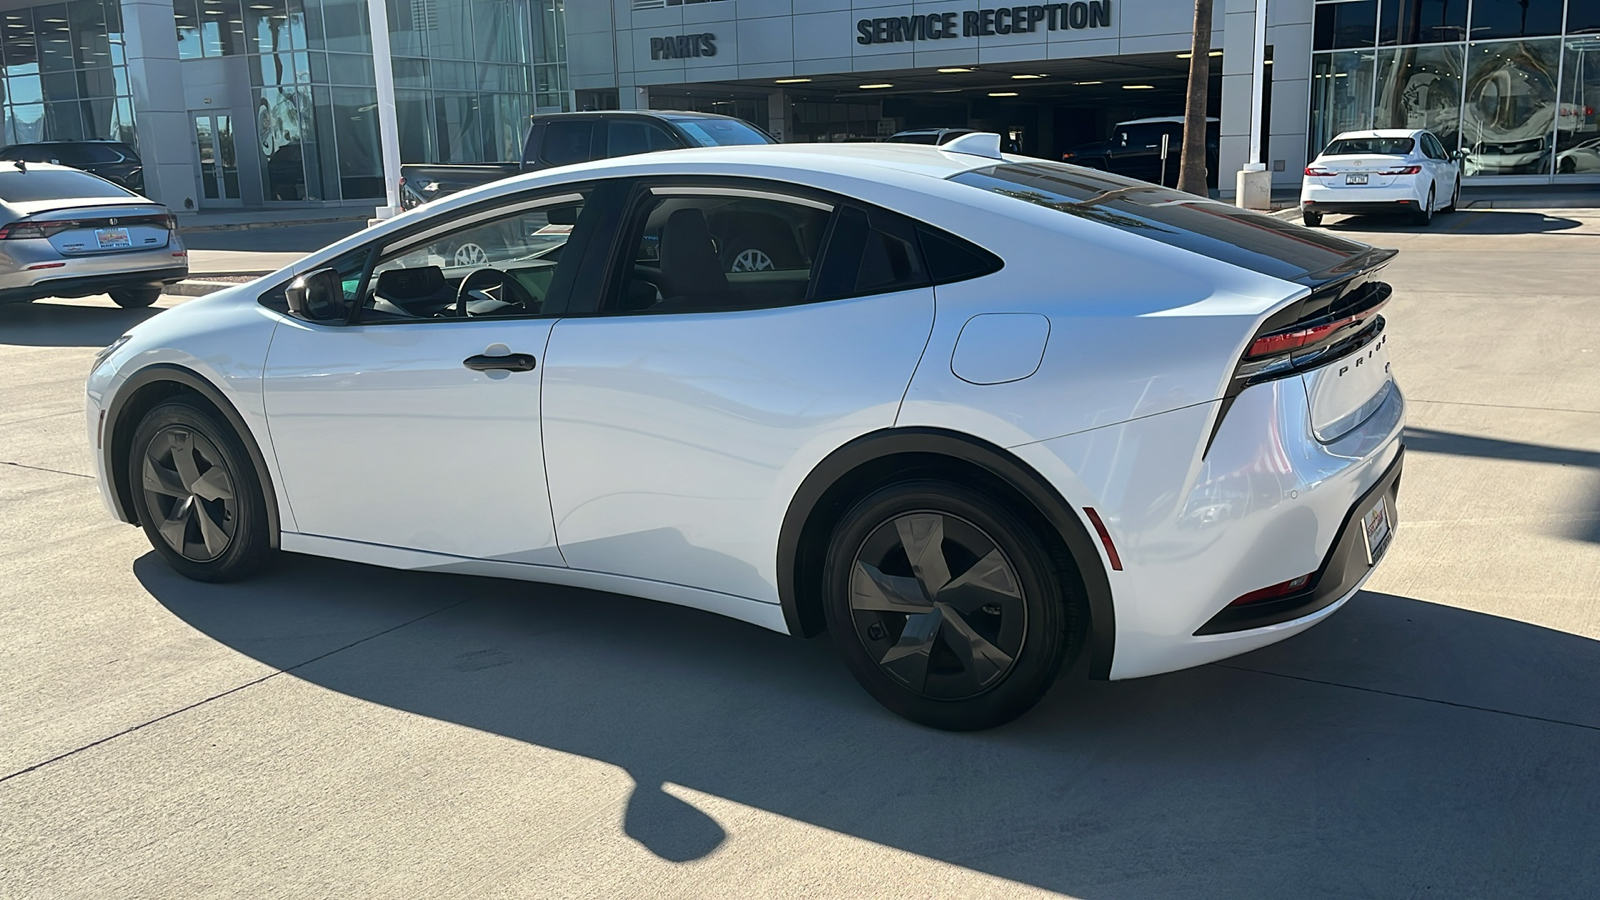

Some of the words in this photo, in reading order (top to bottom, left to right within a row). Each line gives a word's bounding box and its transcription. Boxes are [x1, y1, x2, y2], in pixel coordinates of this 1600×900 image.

[857, 12, 957, 45] SERVICE
[963, 0, 1110, 38] RECEPTION
[650, 33, 717, 60] PARTS
[1339, 334, 1387, 377] PRIUS
